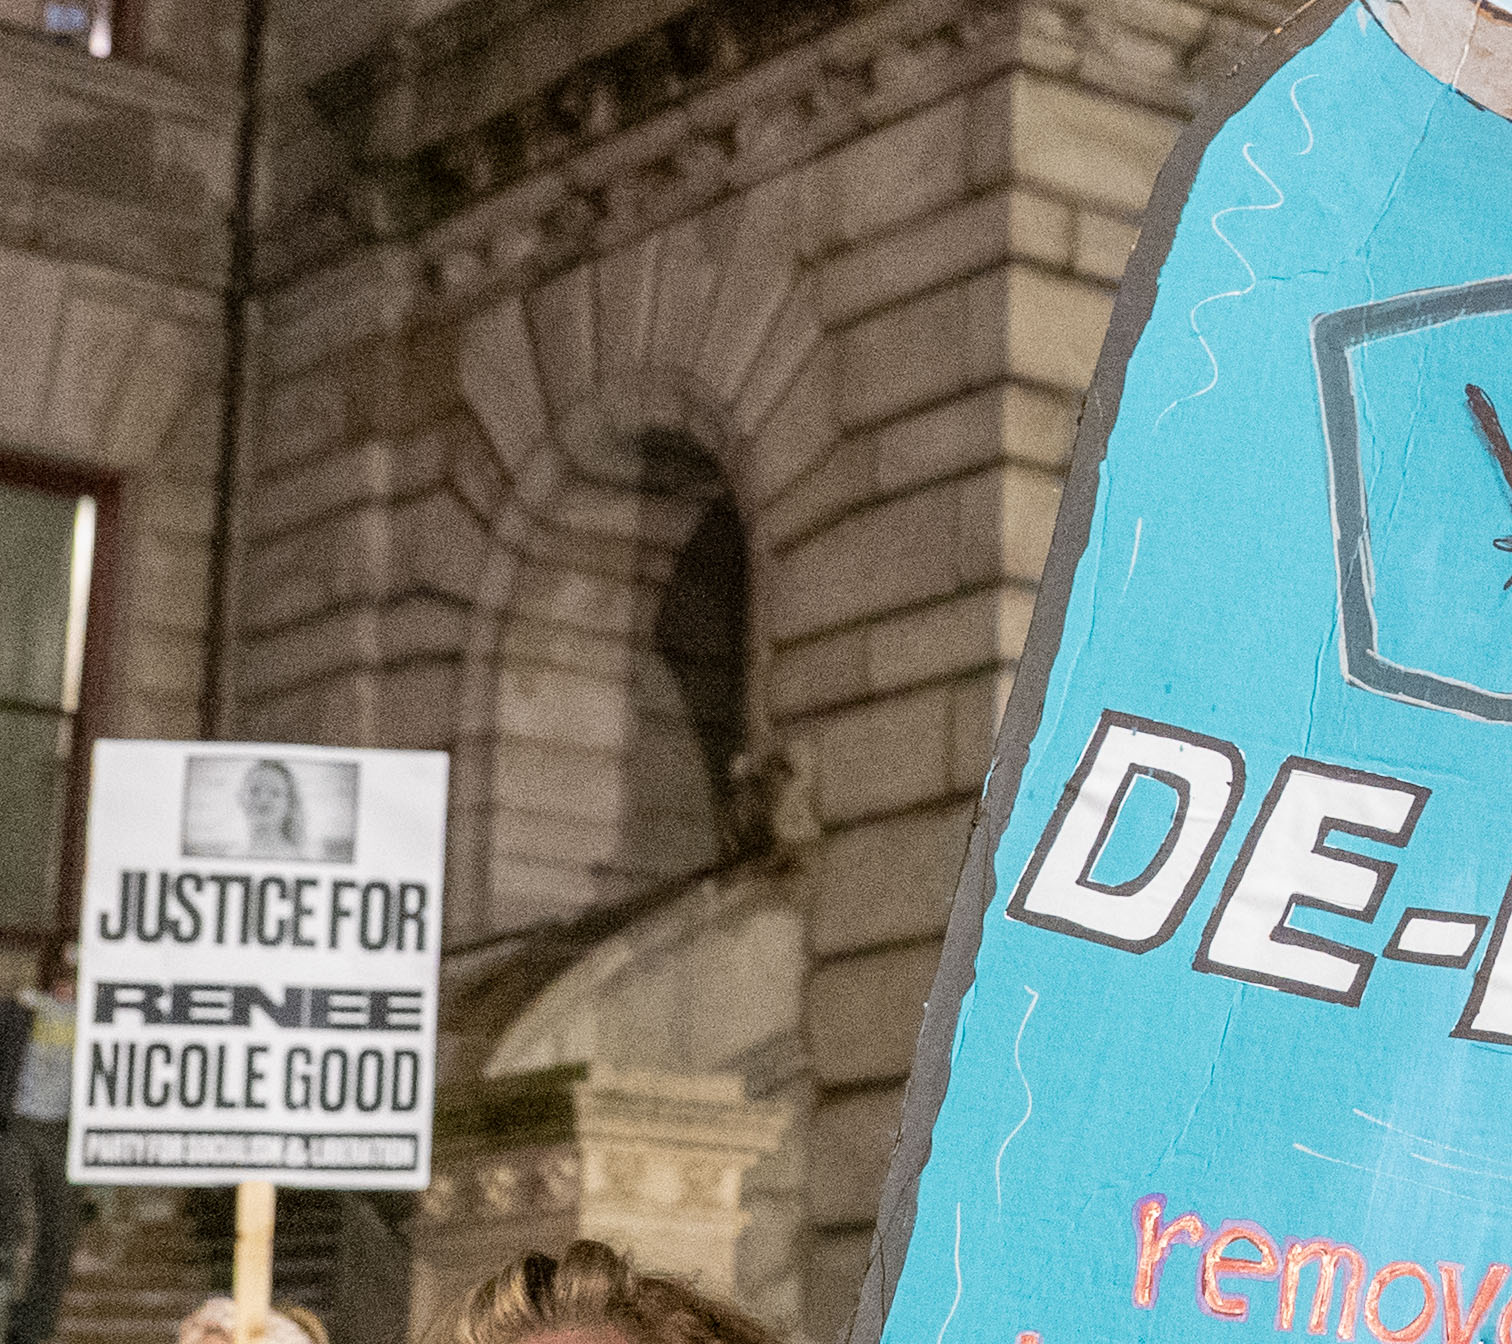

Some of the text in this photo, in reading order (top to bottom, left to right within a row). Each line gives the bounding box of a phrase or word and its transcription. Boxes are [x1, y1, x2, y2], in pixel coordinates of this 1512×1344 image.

[98, 870, 427, 952] JUSTICE FOR
[94, 982, 422, 1032] RENEE
[88, 1042, 421, 1114] NICOLE GOOD
